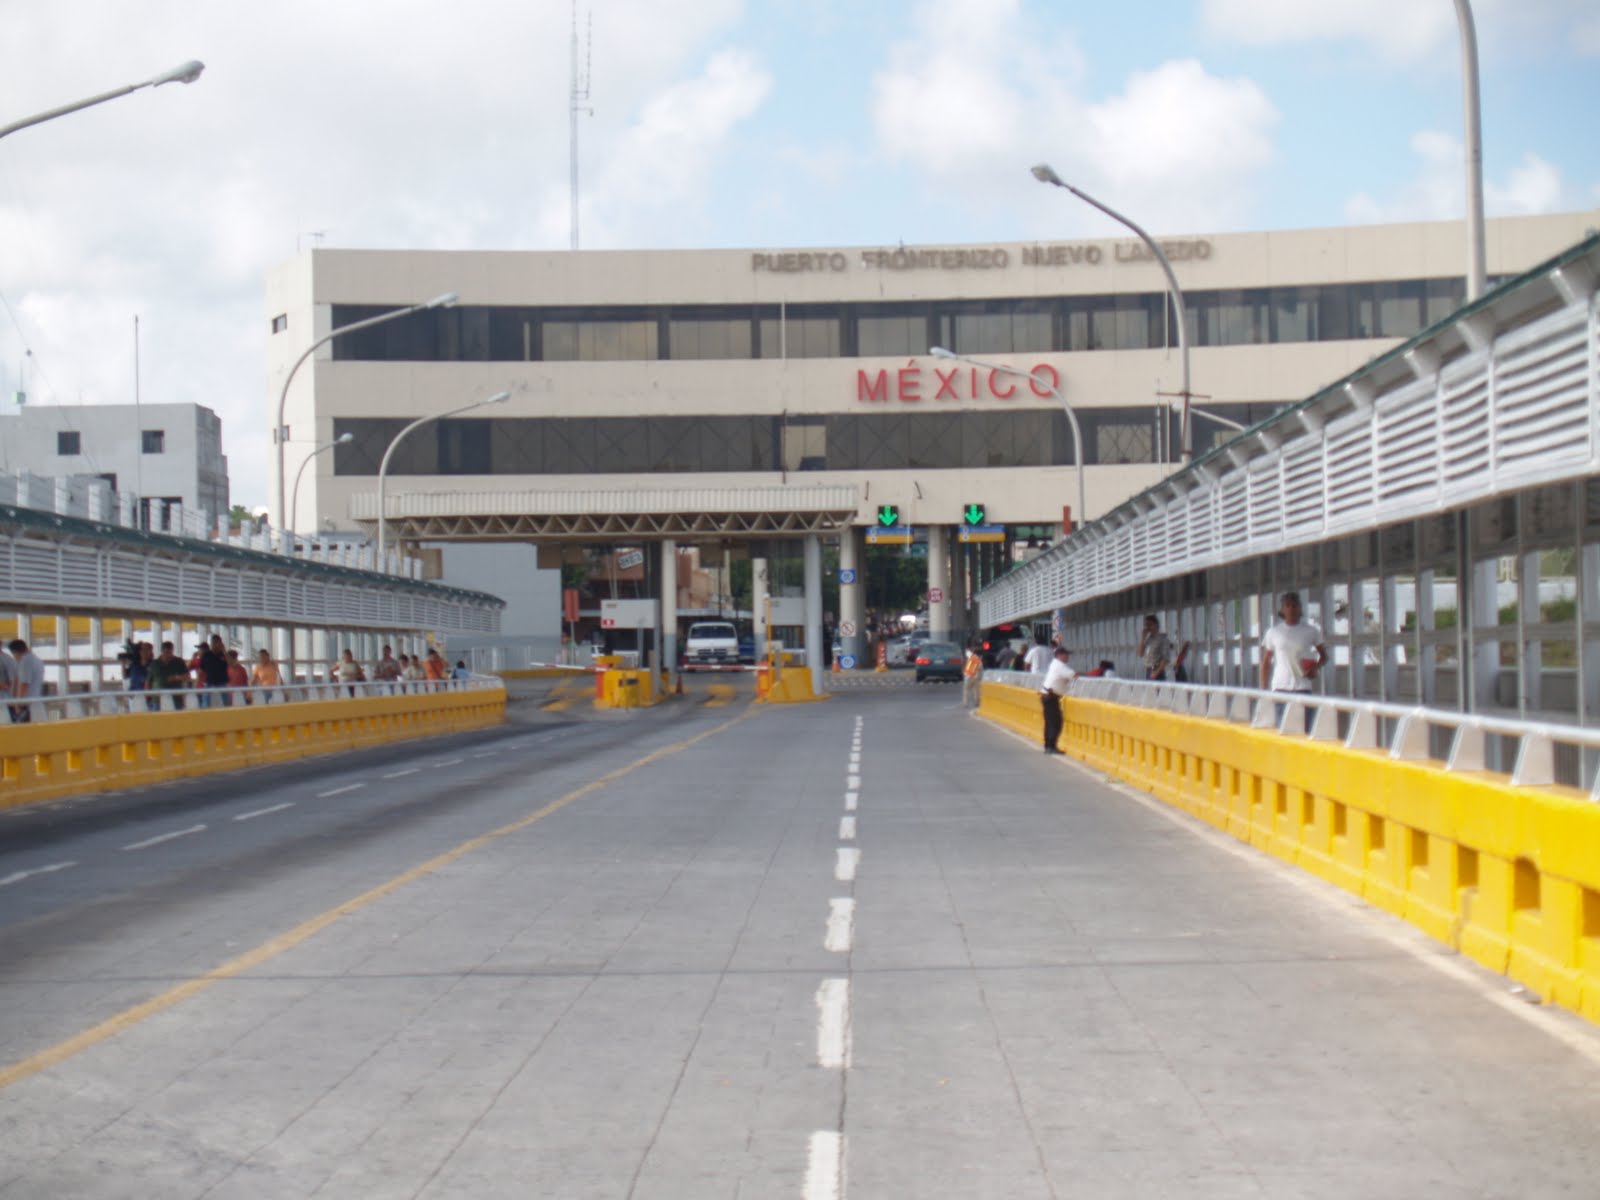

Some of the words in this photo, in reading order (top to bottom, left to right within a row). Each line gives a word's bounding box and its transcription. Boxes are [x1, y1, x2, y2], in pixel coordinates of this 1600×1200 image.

[751, 252, 847, 273] PUERTO
[861, 248, 1009, 272] FRONTERIZO
[1022, 245, 1102, 266] NUEVO
[1114, 240, 1212, 262] LAEDO
[857, 359, 1060, 402] MÉXICO
